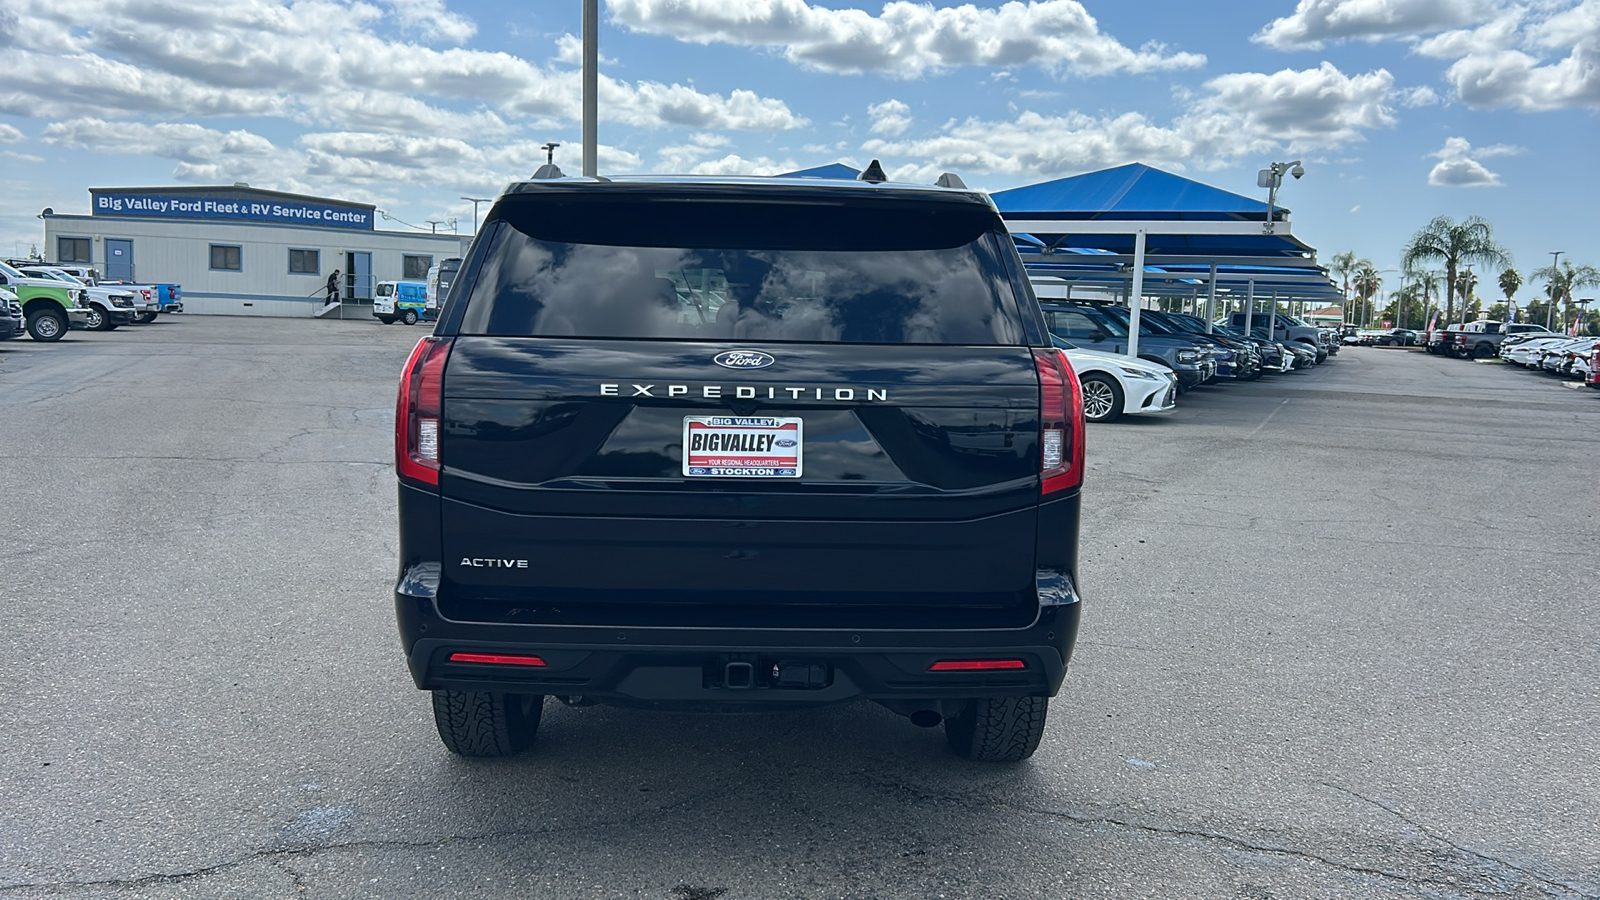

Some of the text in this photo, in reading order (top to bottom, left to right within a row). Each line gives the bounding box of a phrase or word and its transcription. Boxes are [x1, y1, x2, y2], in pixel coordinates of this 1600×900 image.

[99, 197, 366, 223] Big Valley Ford Fleet & RV Service Center
[725, 353, 763, 367] Ford
[600, 383, 887, 401] EXPEDITION
[711, 468, 774, 476] STOCKTON
[460, 557, 528, 568] ACTIVE
